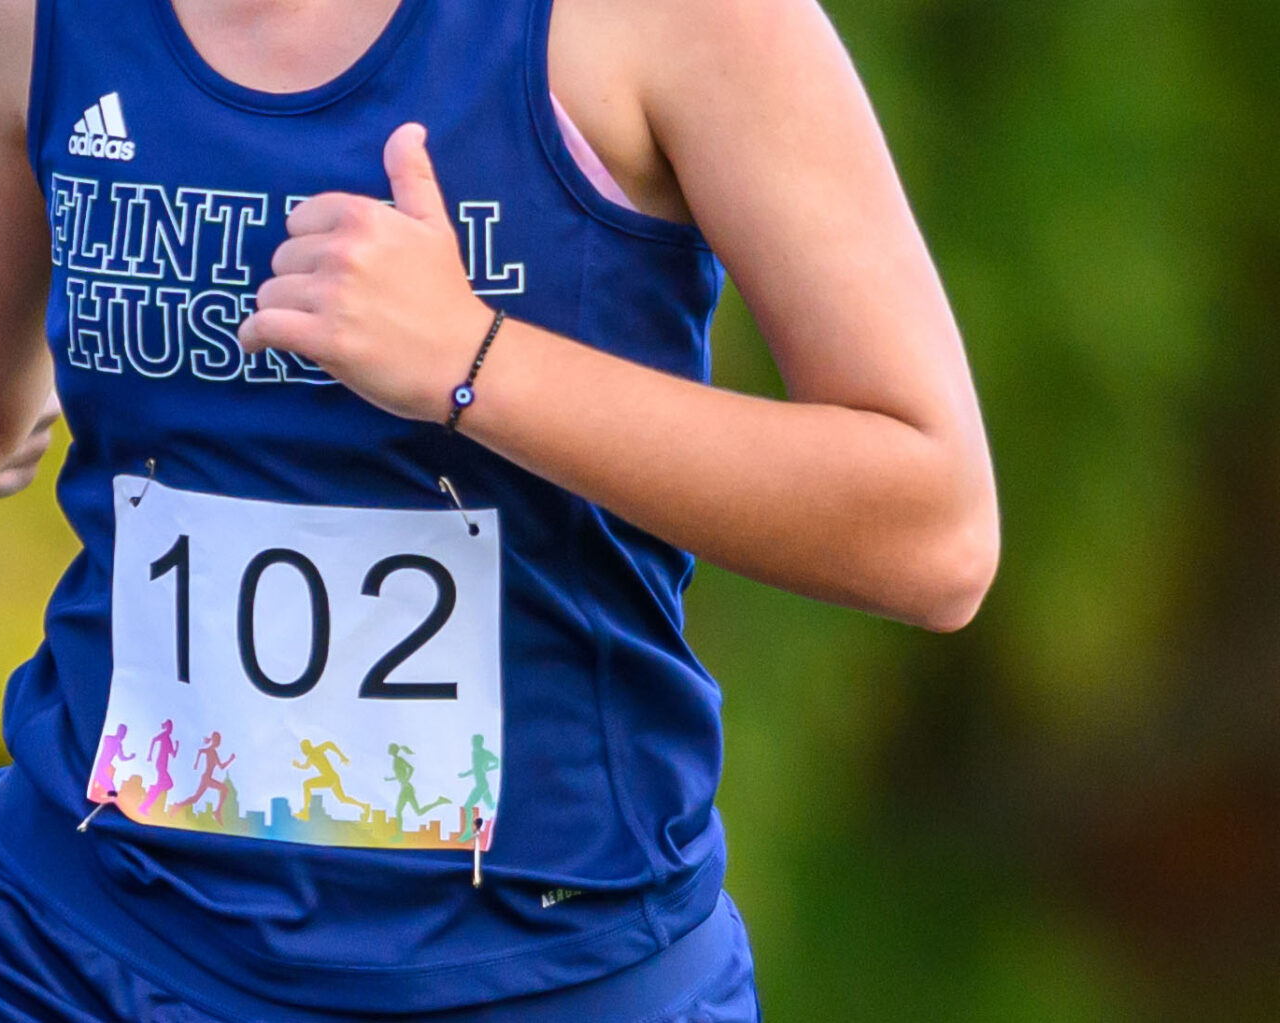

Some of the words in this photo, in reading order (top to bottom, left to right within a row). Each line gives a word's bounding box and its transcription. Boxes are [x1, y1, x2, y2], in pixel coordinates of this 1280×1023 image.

[68, 133, 136, 162] adidas
[50, 172, 268, 285] FLINT
[150, 534, 458, 699] 102
